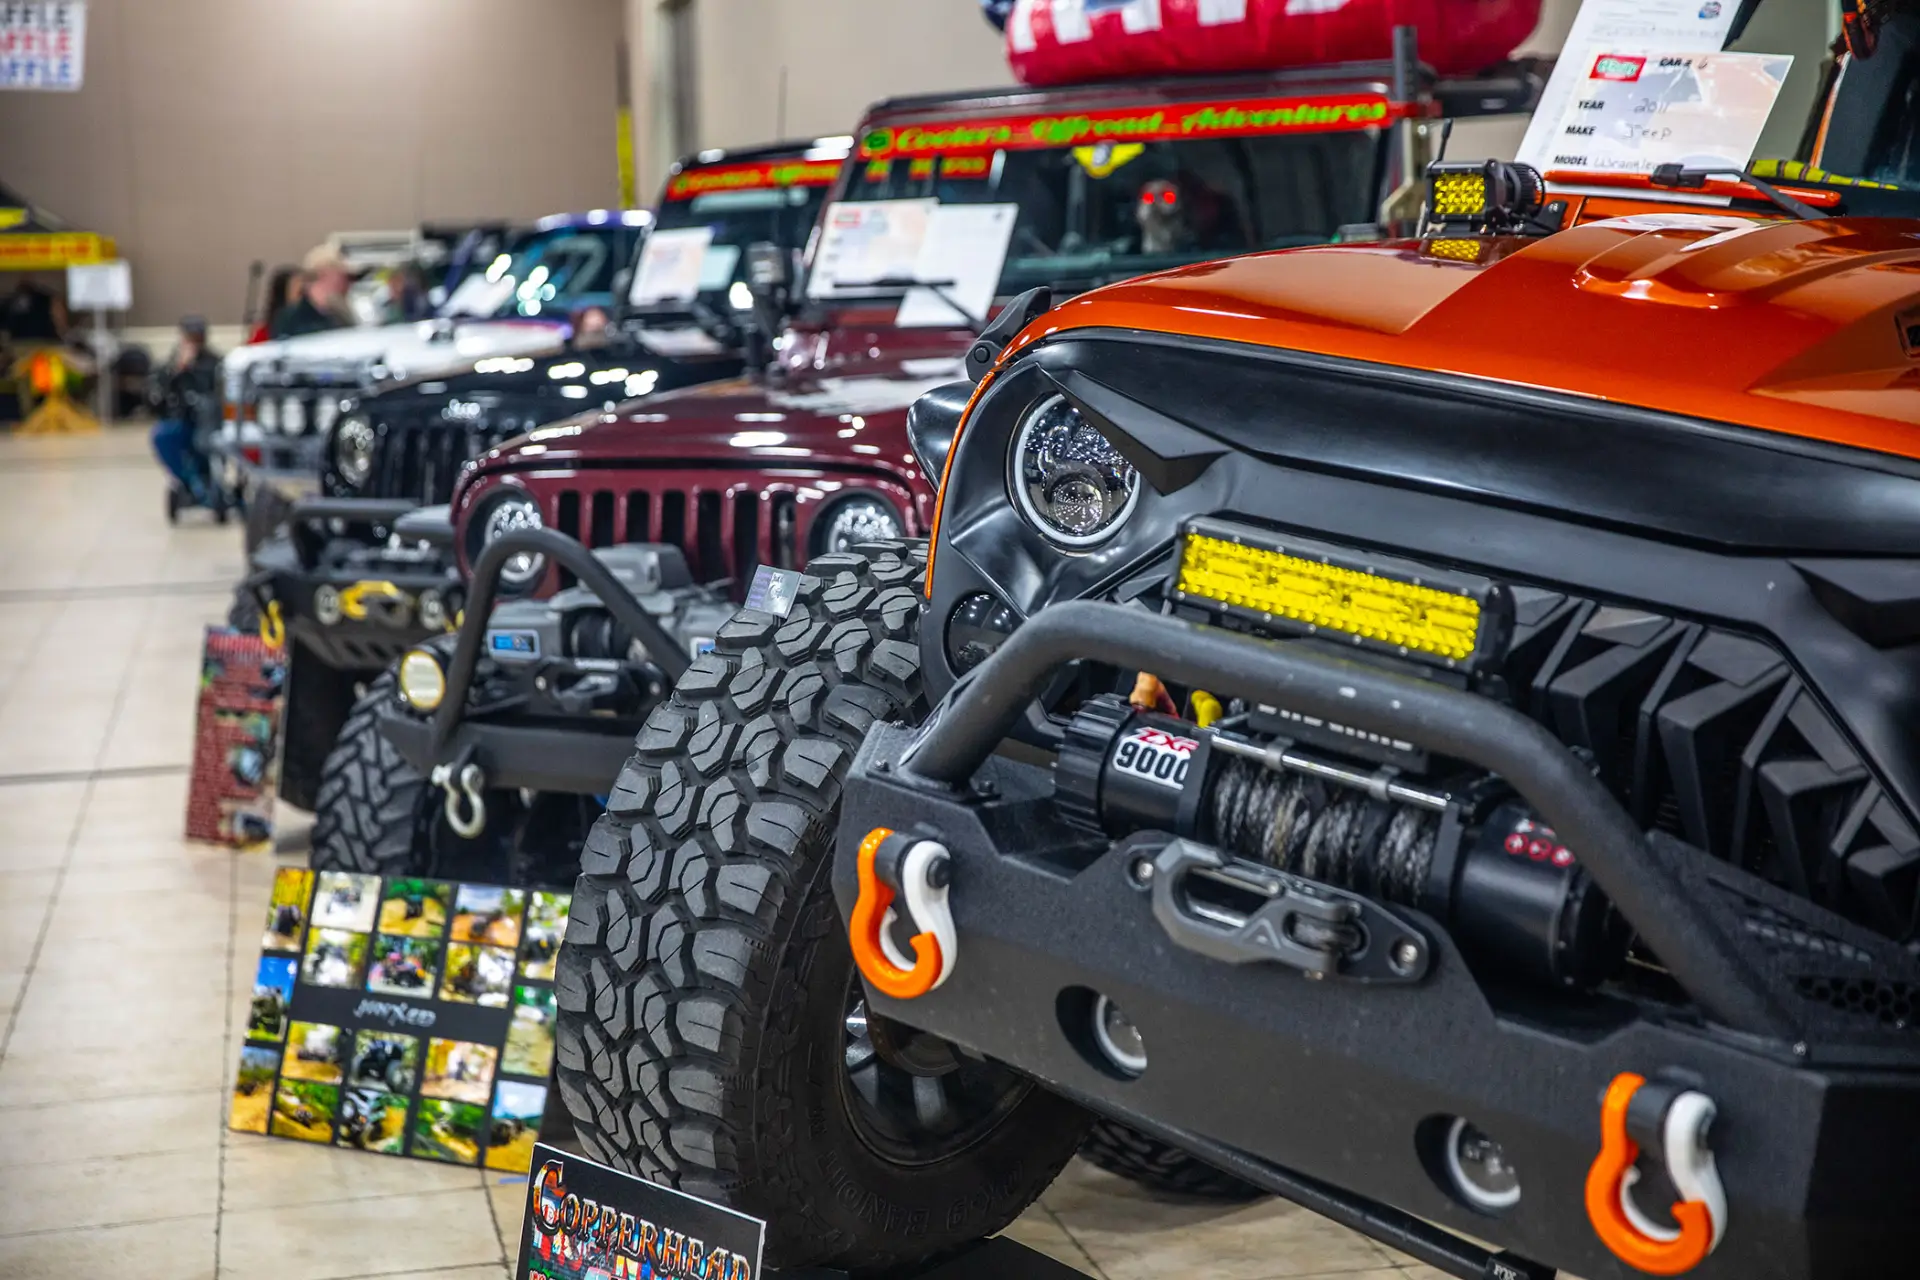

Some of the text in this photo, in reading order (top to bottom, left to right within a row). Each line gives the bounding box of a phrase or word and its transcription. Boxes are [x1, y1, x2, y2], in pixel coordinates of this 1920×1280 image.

[1578, 100, 1604, 109] YEAR
[1565, 125, 1597, 135] MAKE
[1553, 155, 1588, 166] MODEL
